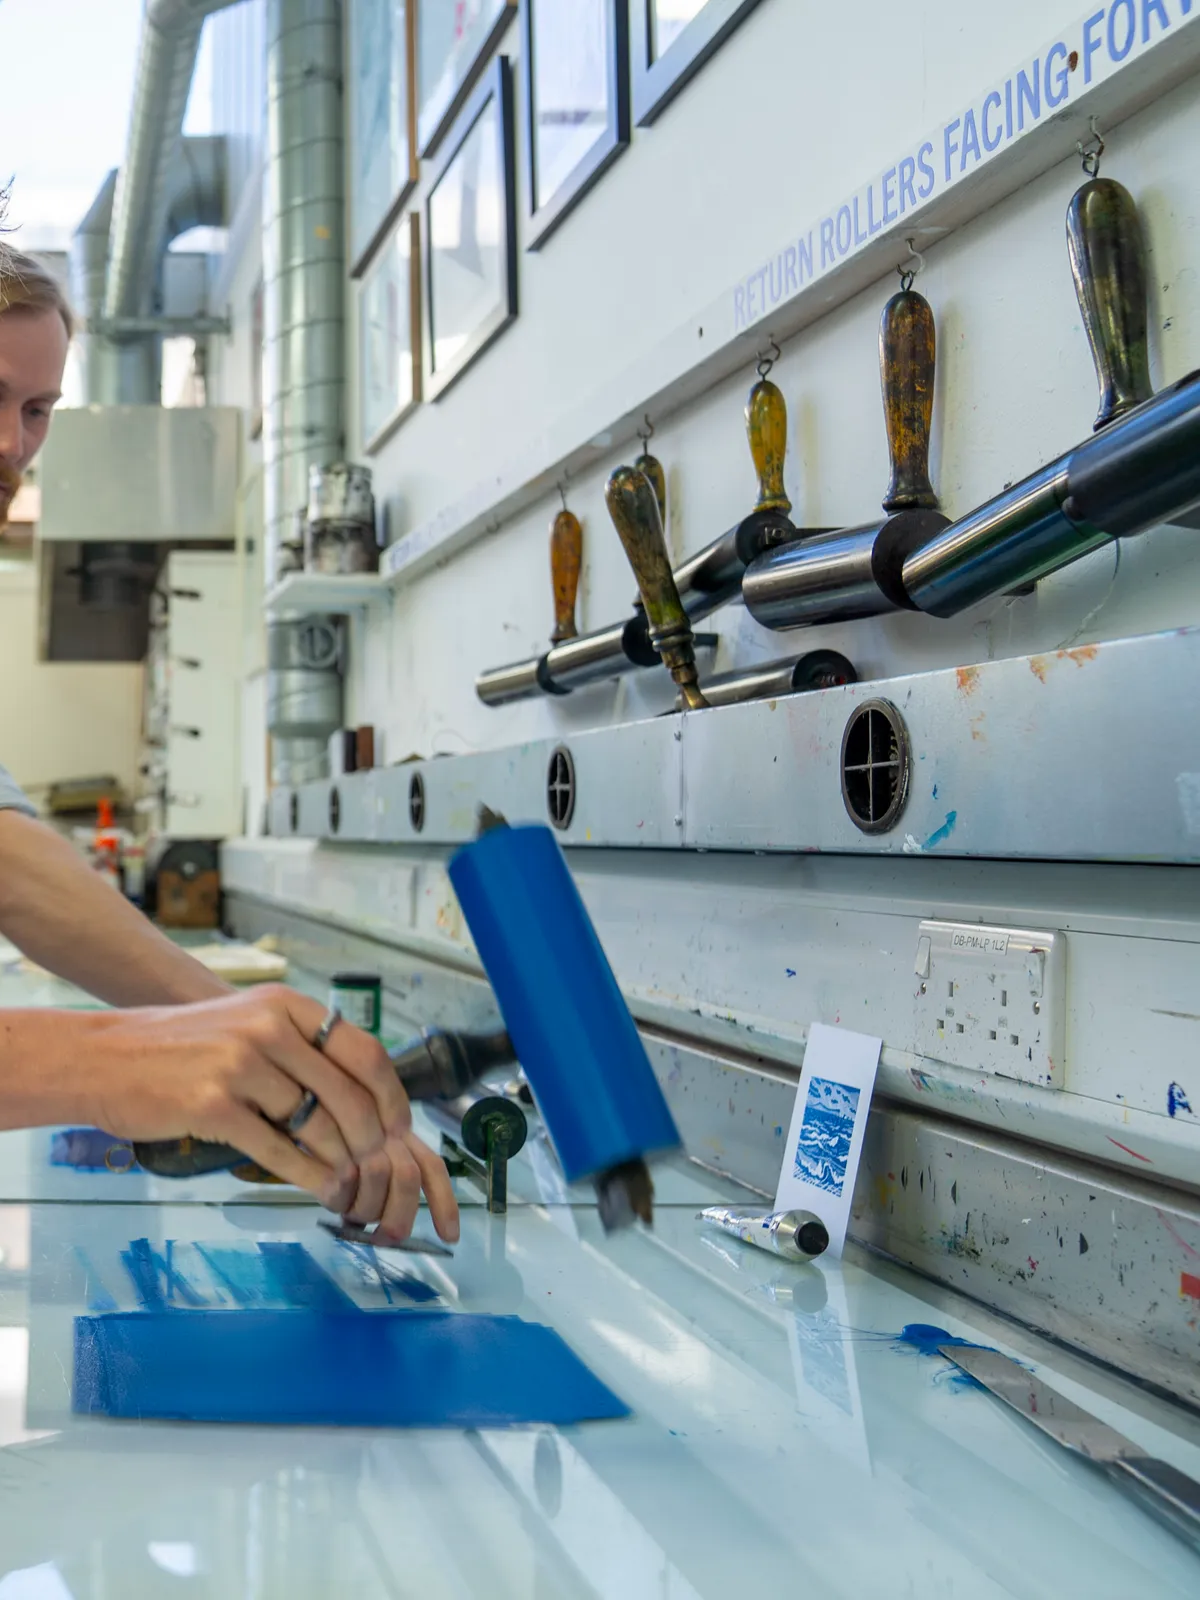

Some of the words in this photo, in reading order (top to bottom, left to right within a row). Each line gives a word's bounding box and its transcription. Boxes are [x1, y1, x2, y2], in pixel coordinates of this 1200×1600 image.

[734, 230, 814, 331] RETURN
[820, 142, 935, 270] ROLLERS
[944, 41, 1069, 183] FACING
[1083, 0, 1193, 85] FOR
